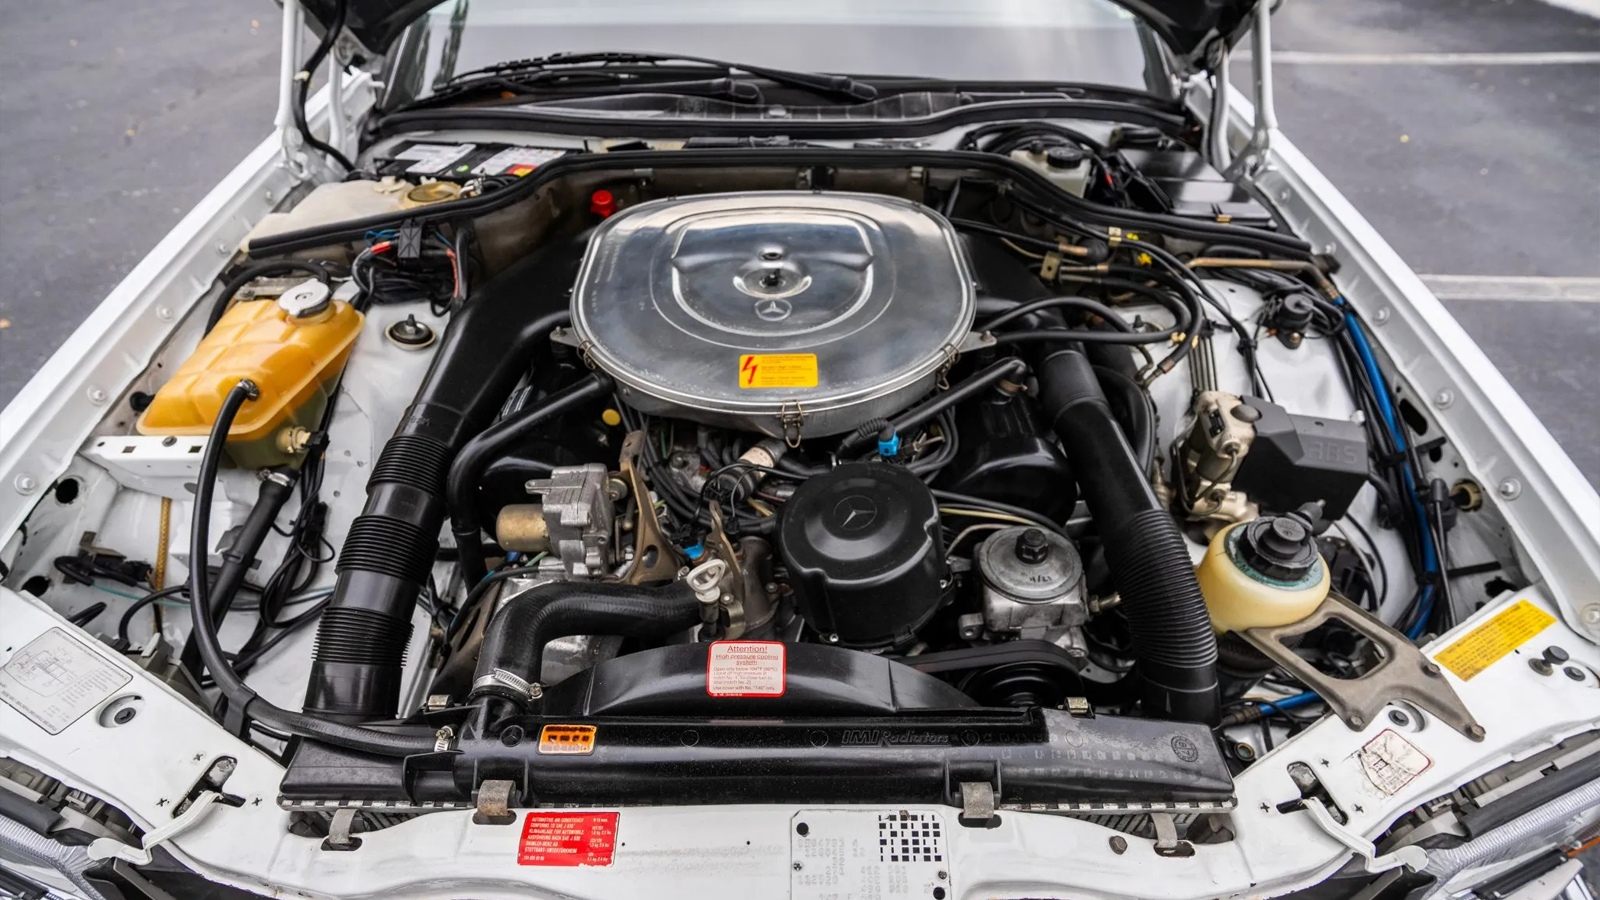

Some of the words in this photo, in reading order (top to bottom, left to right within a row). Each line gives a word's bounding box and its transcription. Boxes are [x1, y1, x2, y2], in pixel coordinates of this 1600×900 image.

[1311, 440, 1357, 464] ABS
[841, 730, 880, 744] IMI
[878, 730, 949, 748] Radiators
